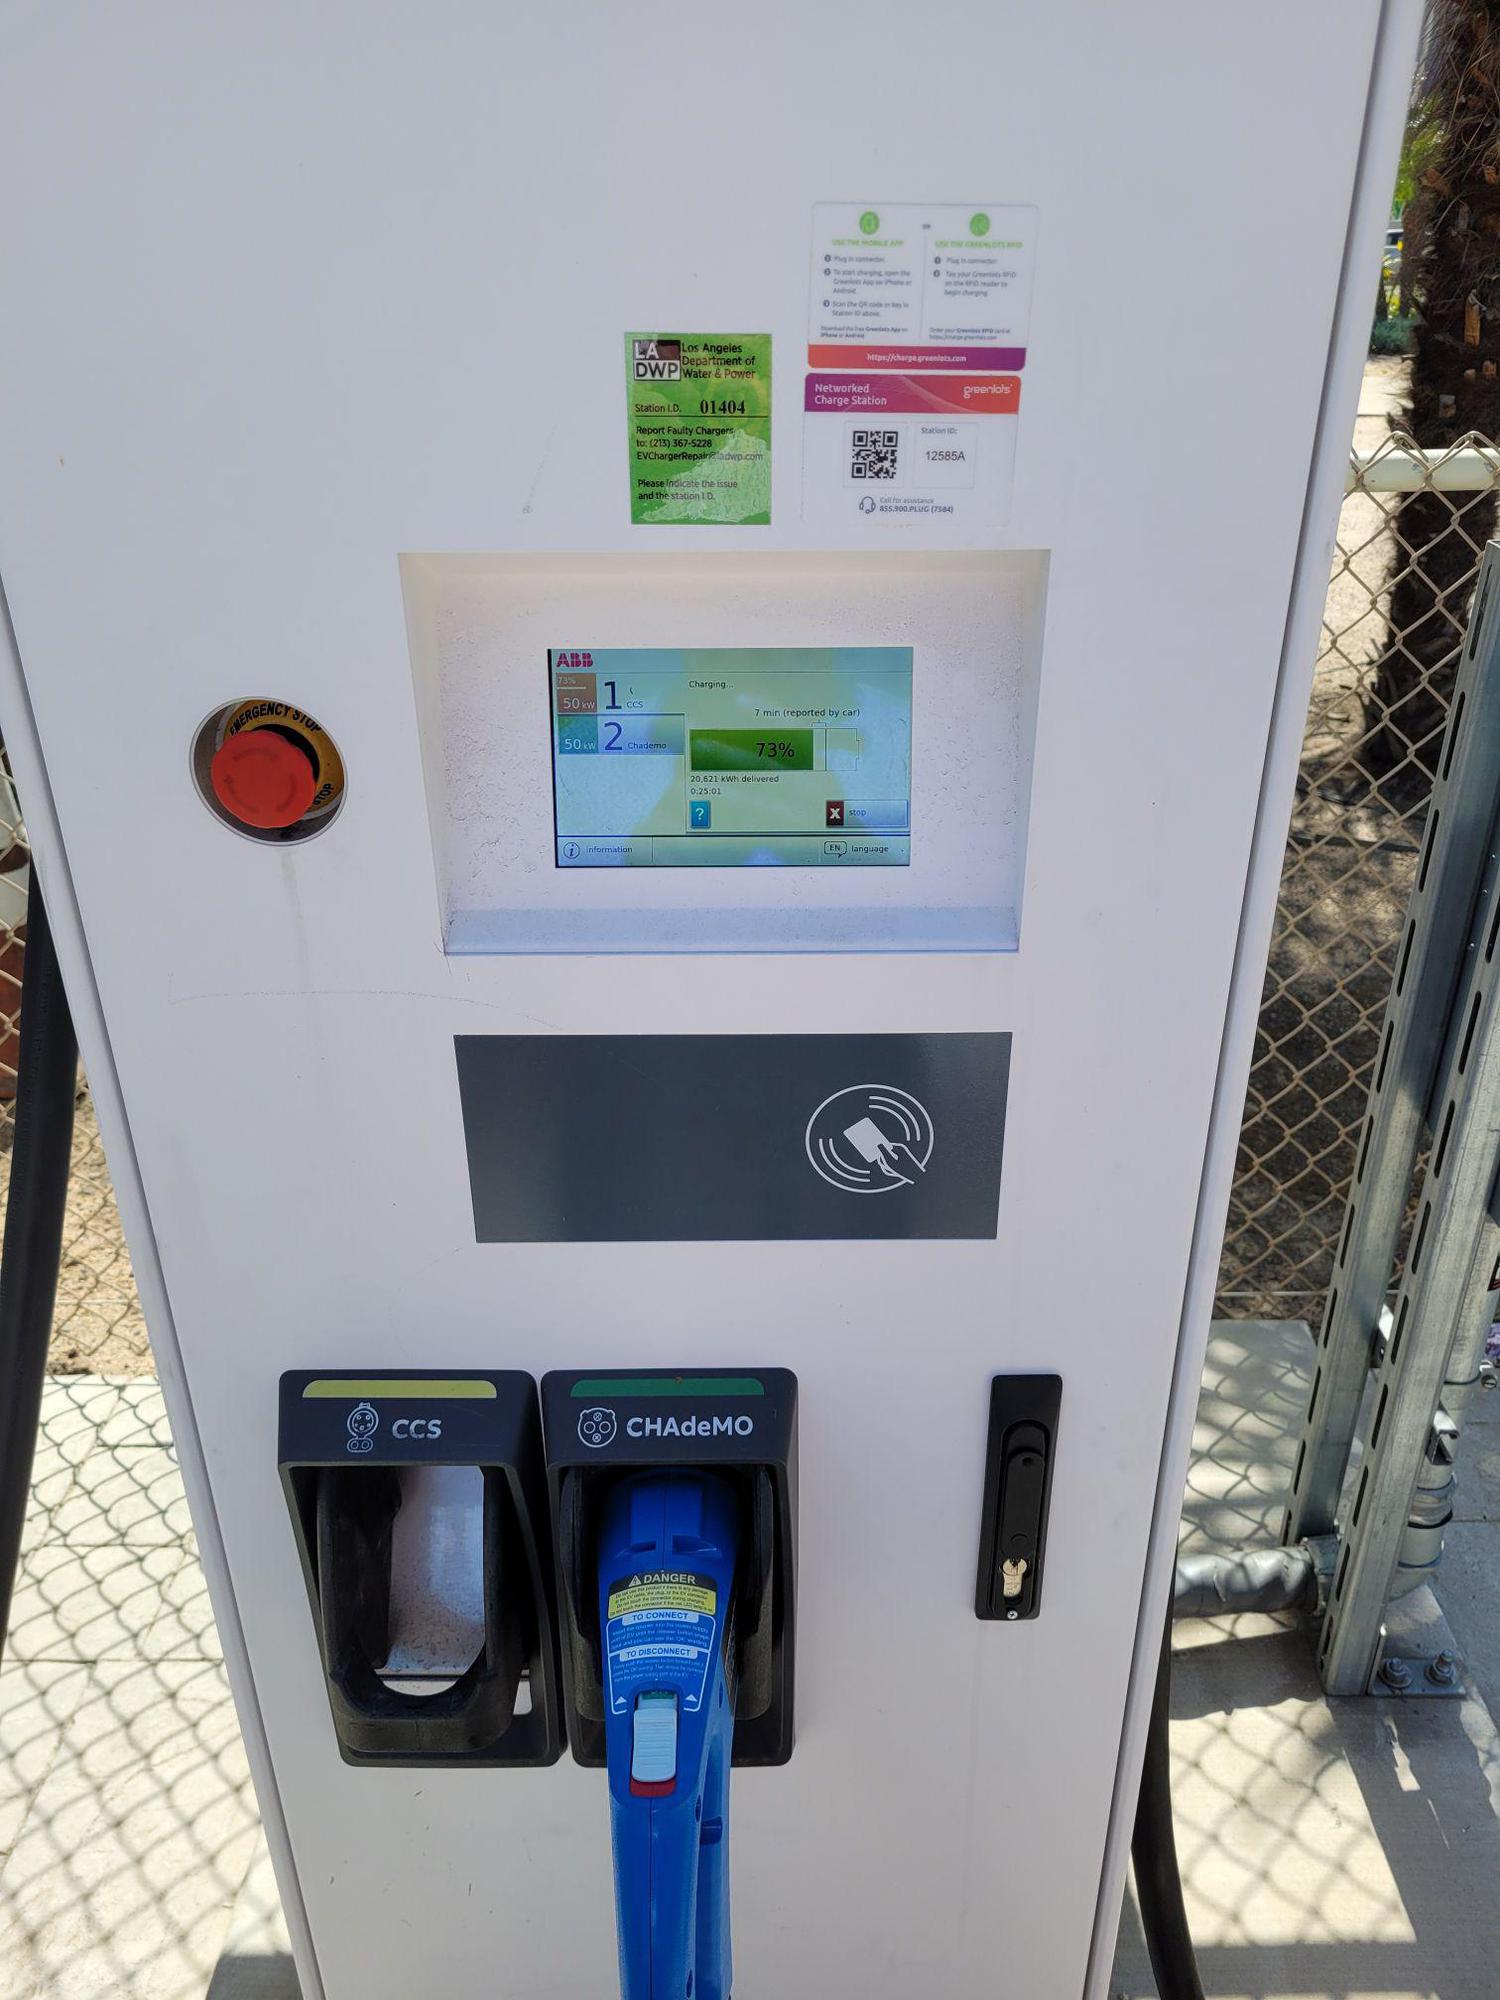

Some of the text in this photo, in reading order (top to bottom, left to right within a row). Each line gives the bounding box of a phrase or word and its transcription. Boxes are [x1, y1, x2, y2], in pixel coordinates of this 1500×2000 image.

[635, 342, 660, 359] LA
[682, 343, 742, 355] Los Angeles
[682, 355, 756, 367] Department of
[867, 353, 967, 363] https://charge.greenlots.com
[636, 362, 679, 378] DWP
[683, 368, 756, 379] Water & Power
[815, 383, 870, 394] Networked
[963, 384, 1010, 399] greenlots
[815, 395, 887, 406] Charge Station
[635, 399, 746, 414] Station I.D. 01404
[637, 426, 665, 436] Report
[667, 426, 693, 436] Faulty
[921, 427, 957, 435] Station ID:
[637, 439, 712, 448] to: (213) 367-5228
[926, 451, 965, 461] 12585A
[638, 480, 738, 488] Please indicate the issue
[638, 491, 654, 500] and
[656, 491, 669, 500] the
[671, 492, 700, 500] station
[892, 495, 902, 503] for
[556, 653, 594, 668] ABB
[558, 677, 577, 685] 73%
[688, 680, 734, 689] Charging...
[604, 681, 623, 710] 1
[563, 698, 595, 709] 50 kW
[626, 701, 644, 709] CCS
[230, 703, 322, 735] EMERGENCY STOP
[755, 708, 861, 719] 7 min (reported by car)
[604, 721, 623, 751] 2
[564, 739, 596, 750] 50 kW
[628, 741, 667, 750] Chademo
[756, 742, 795, 758] 73%
[721, 775, 739, 783] kWh
[741, 774, 779, 783] delivered
[690, 787, 721, 795] 0:25:01
[849, 809, 867, 818] stop
[586, 845, 633, 854] information
[829, 844, 889, 854] EN language
[391, 1418, 443, 1440] CCS
[626, 1416, 754, 1438] CHAdeMO
[643, 1573, 697, 1585] DANGER
[632, 1611, 689, 1621] TO CONNECT
[626, 1648, 692, 1659] TO DISCONNECT
